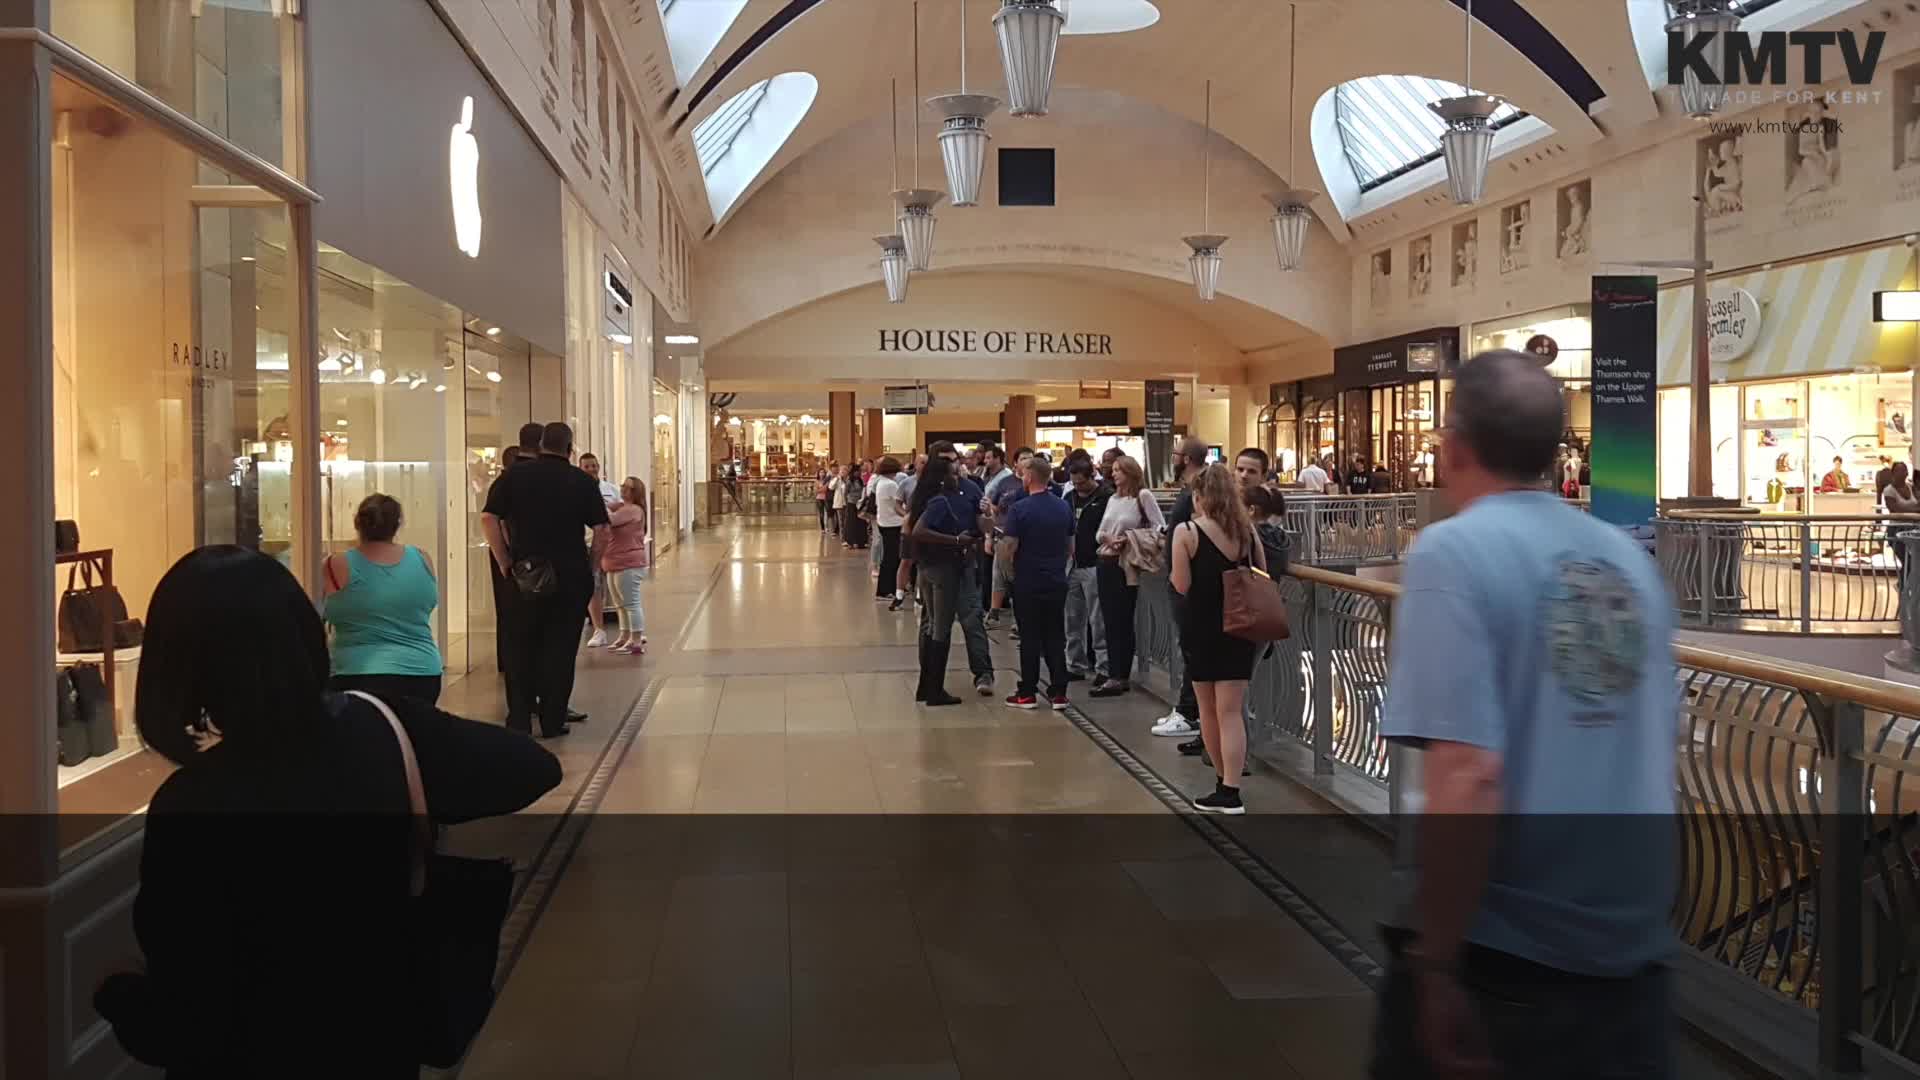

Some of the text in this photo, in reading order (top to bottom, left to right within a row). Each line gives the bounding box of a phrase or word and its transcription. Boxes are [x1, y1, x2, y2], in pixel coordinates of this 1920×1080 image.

[878, 329, 1113, 355] HOUSE OF FRASER
[173, 342, 229, 371] RADLEY
[1612, 357, 1627, 366] the
